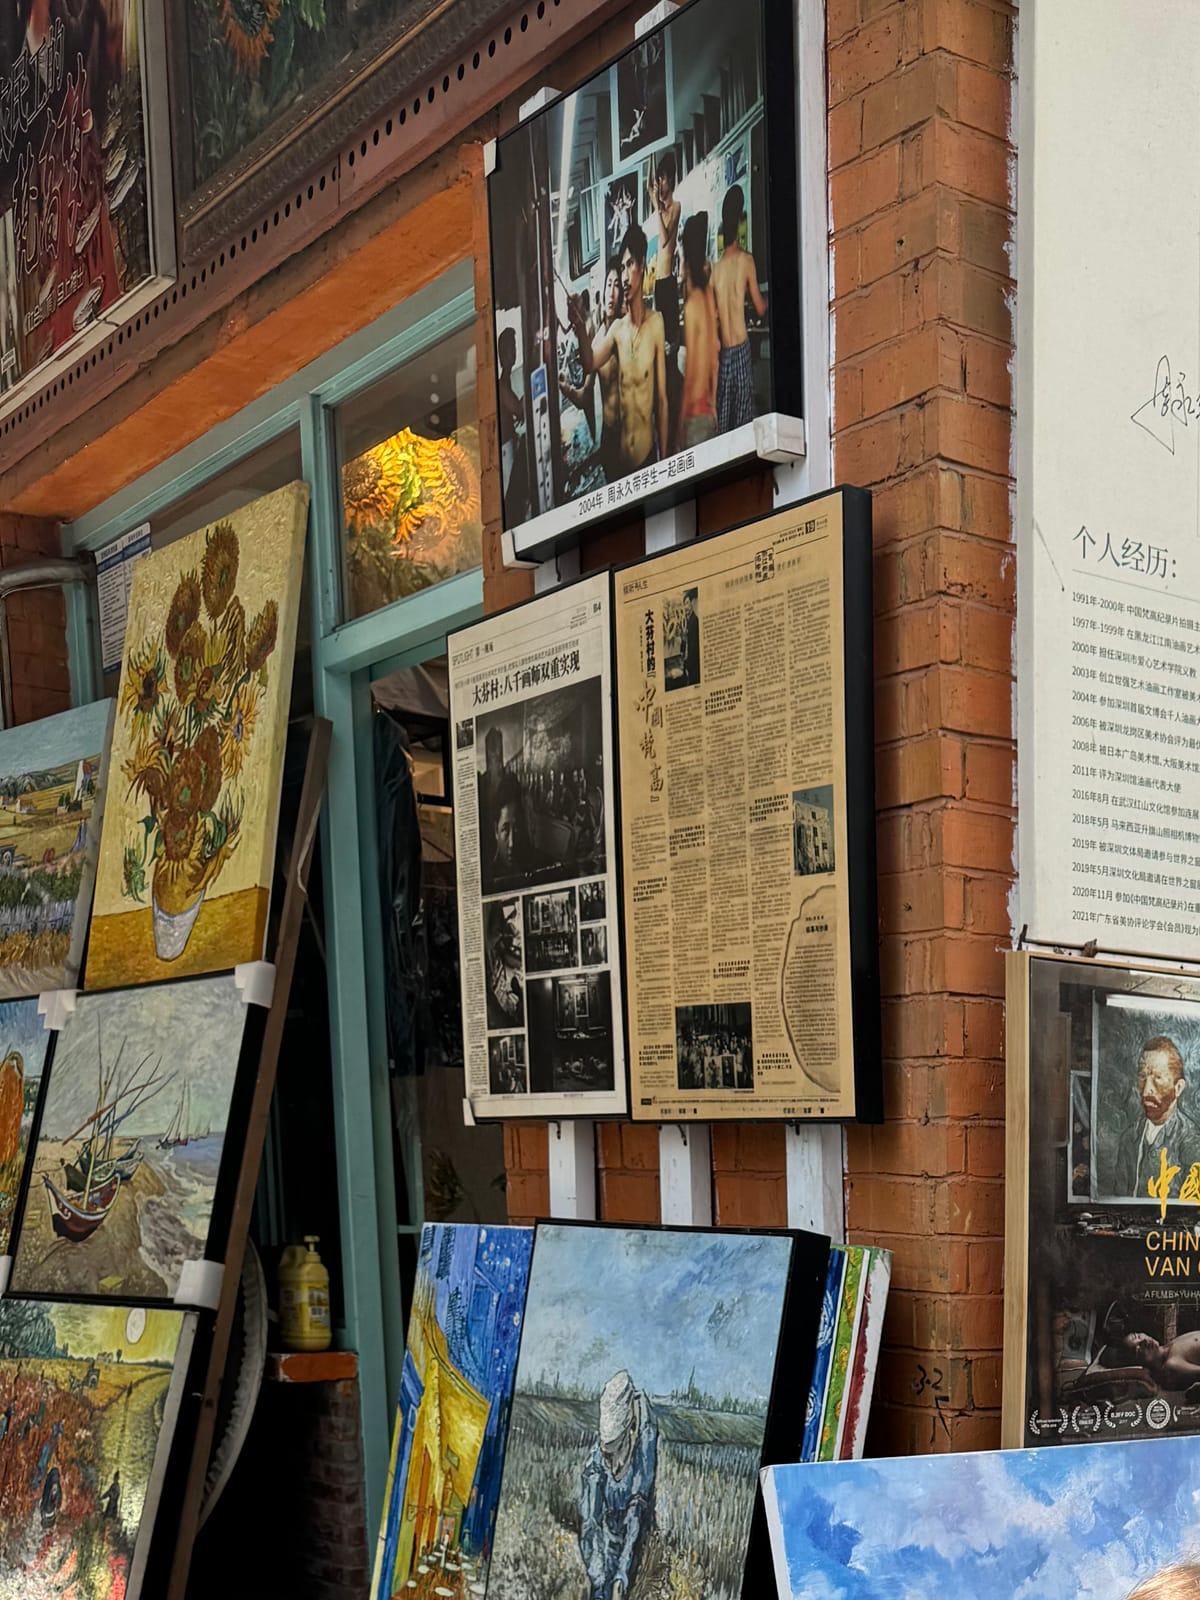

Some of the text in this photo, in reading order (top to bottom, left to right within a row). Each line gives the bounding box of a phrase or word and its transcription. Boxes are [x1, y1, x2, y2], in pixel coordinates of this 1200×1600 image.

[578, 451, 695, 516] 2004年 周永久带学生一起画画
[1072, 525, 1178, 579] 个人经历：
[1071, 640, 1097, 656] 2000年
[1071, 664, 1096, 679] 2003年
[1071, 689, 1097, 703] 2004年
[1071, 714, 1096, 729] 2006年
[1071, 738, 1096, 752] 2008年
[1071, 763, 1096, 777] 2011年
[1071, 787, 1109, 805] 2016年8月
[1071, 812, 1109, 829] 2018年5月
[1071, 836, 1096, 849] 2019年
[1071, 885, 1112, 901] 2020年11月
[1145, 1256, 1189, 1276] VAN
[1144, 1290, 1150, 1299] A
[1151, 1290, 1168, 1299] FILM
[1180, 1290, 1189, 1299] YU
